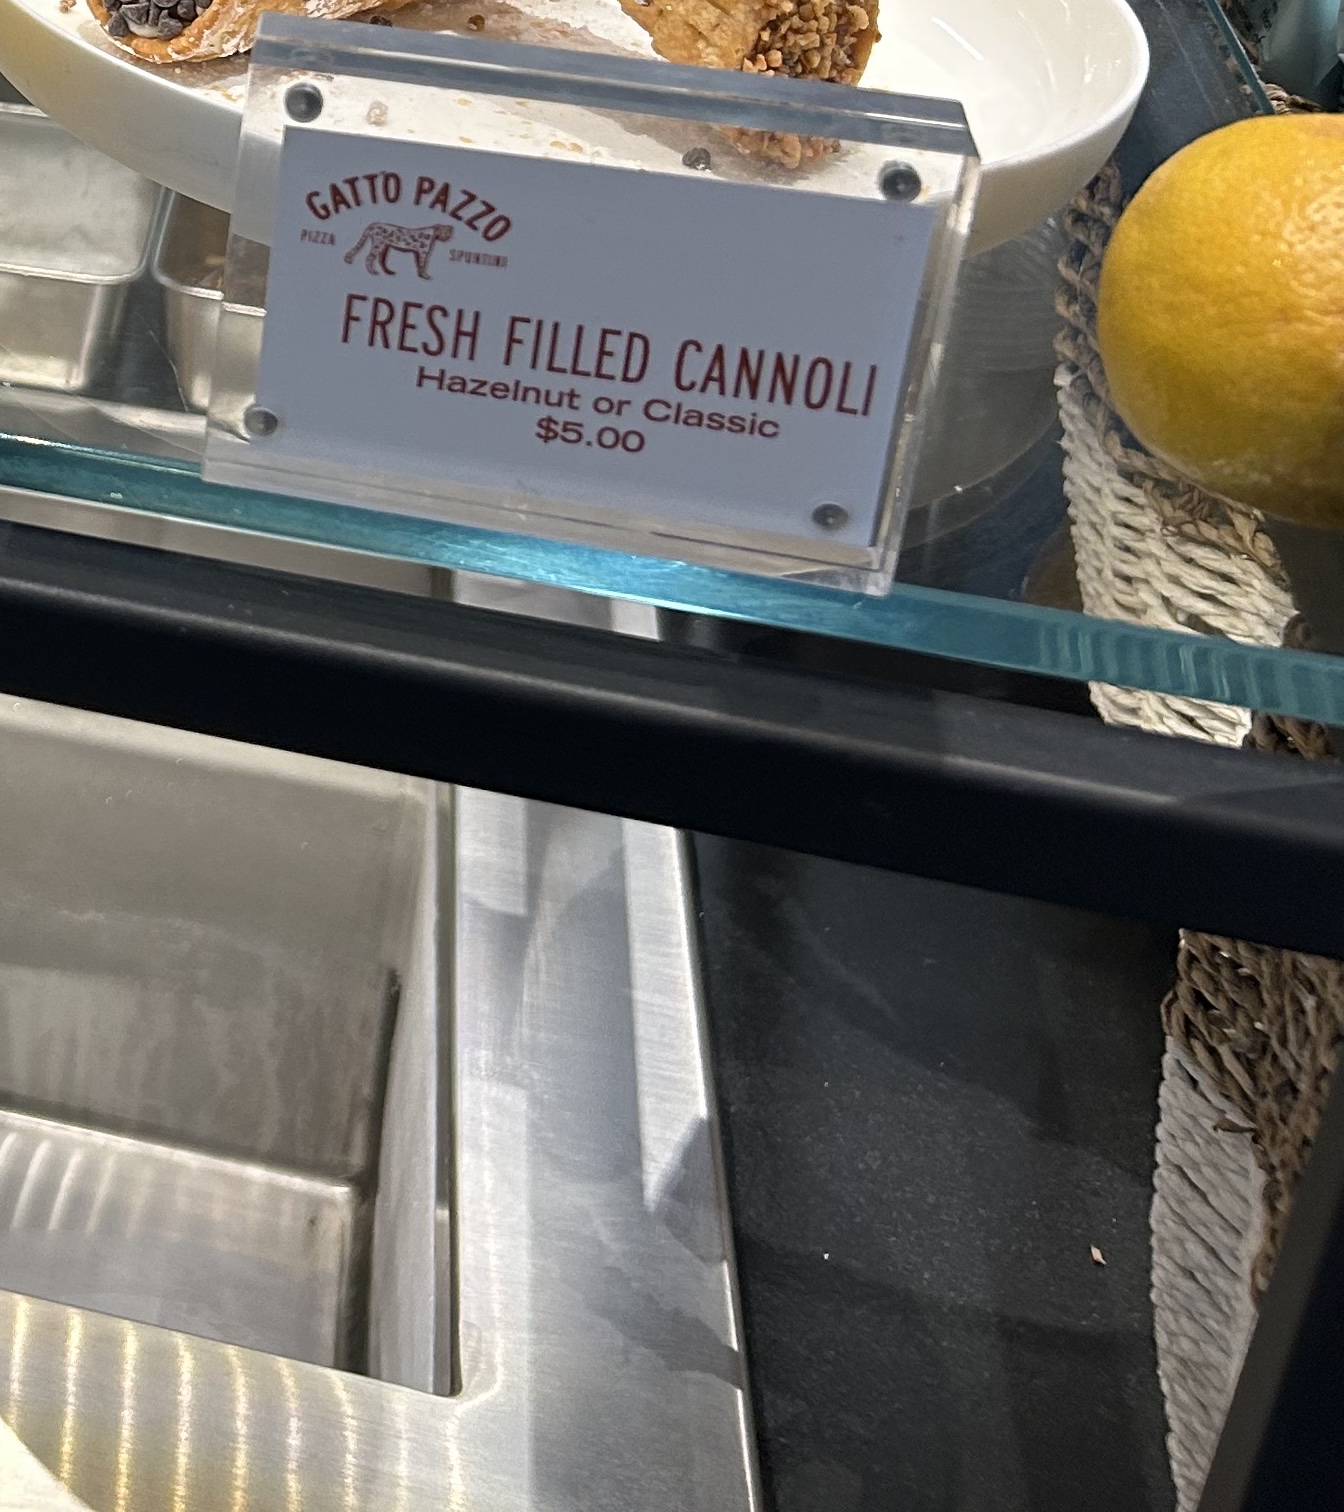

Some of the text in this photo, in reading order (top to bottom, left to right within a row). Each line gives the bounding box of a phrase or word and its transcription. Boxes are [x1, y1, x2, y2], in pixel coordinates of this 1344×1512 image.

[300, 229, 336, 246] PIZZA
[306, 171, 512, 243] GATTO PAZZO
[341, 293, 880, 417] FRESH FILLED CANNOLI
[415, 365, 781, 439] Hazelnut or Classic
[536, 416, 645, 454] $5.00
